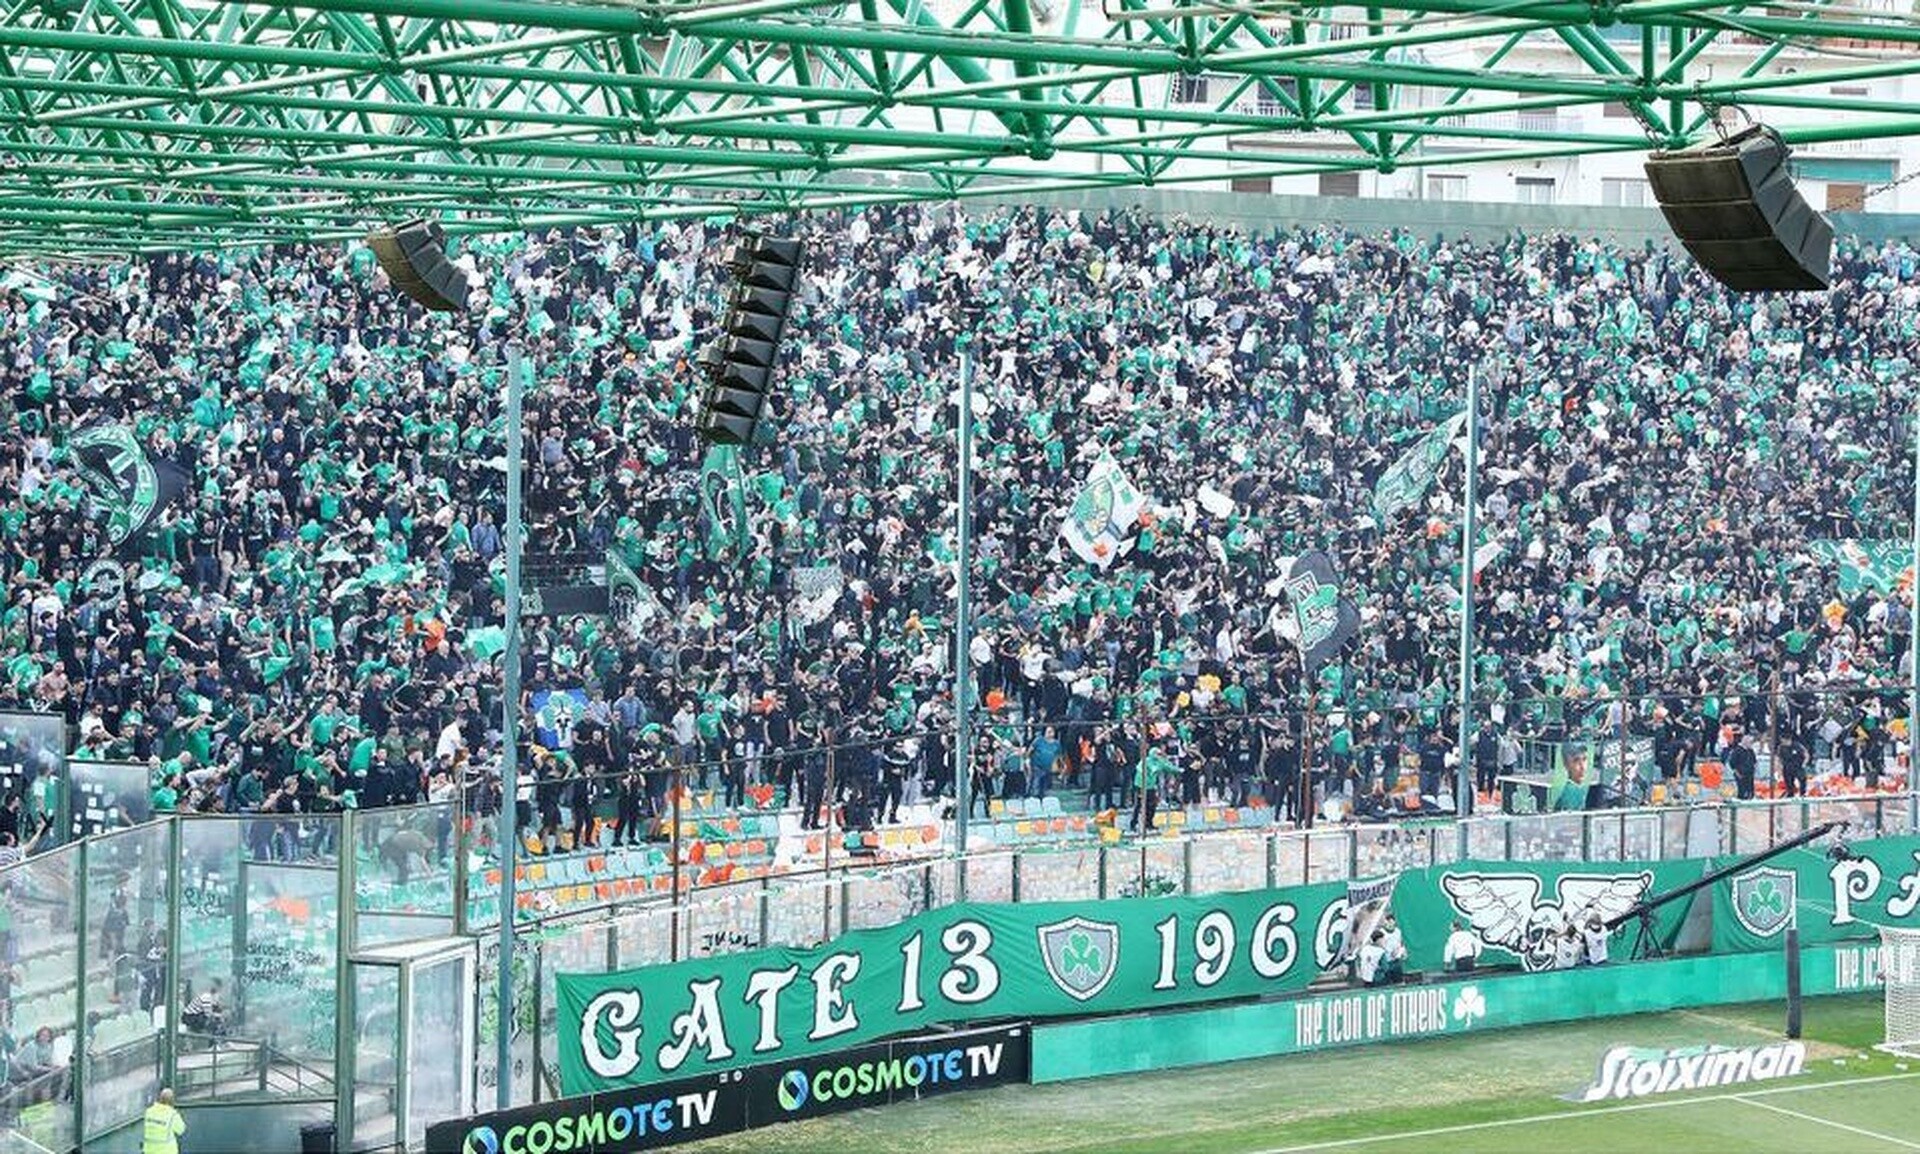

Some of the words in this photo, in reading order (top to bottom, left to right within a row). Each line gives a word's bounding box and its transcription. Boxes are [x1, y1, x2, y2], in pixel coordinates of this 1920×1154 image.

[579, 950, 863, 1079] GATE
[897, 919, 1002, 1013] 13
[1295, 1001, 1322, 1046] THE
[1327, 997, 1362, 1043] ICON
[1366, 993, 1386, 1038] OF
[1390, 988, 1448, 1035] ATHENS
[812, 1048, 964, 1101] COSMOTE
[966, 1043, 1003, 1078] TV
[1584, 1041, 1807, 1102] Stoiximan
[502, 1099, 674, 1154] COSMOTE
[676, 1090, 718, 1129] TV
